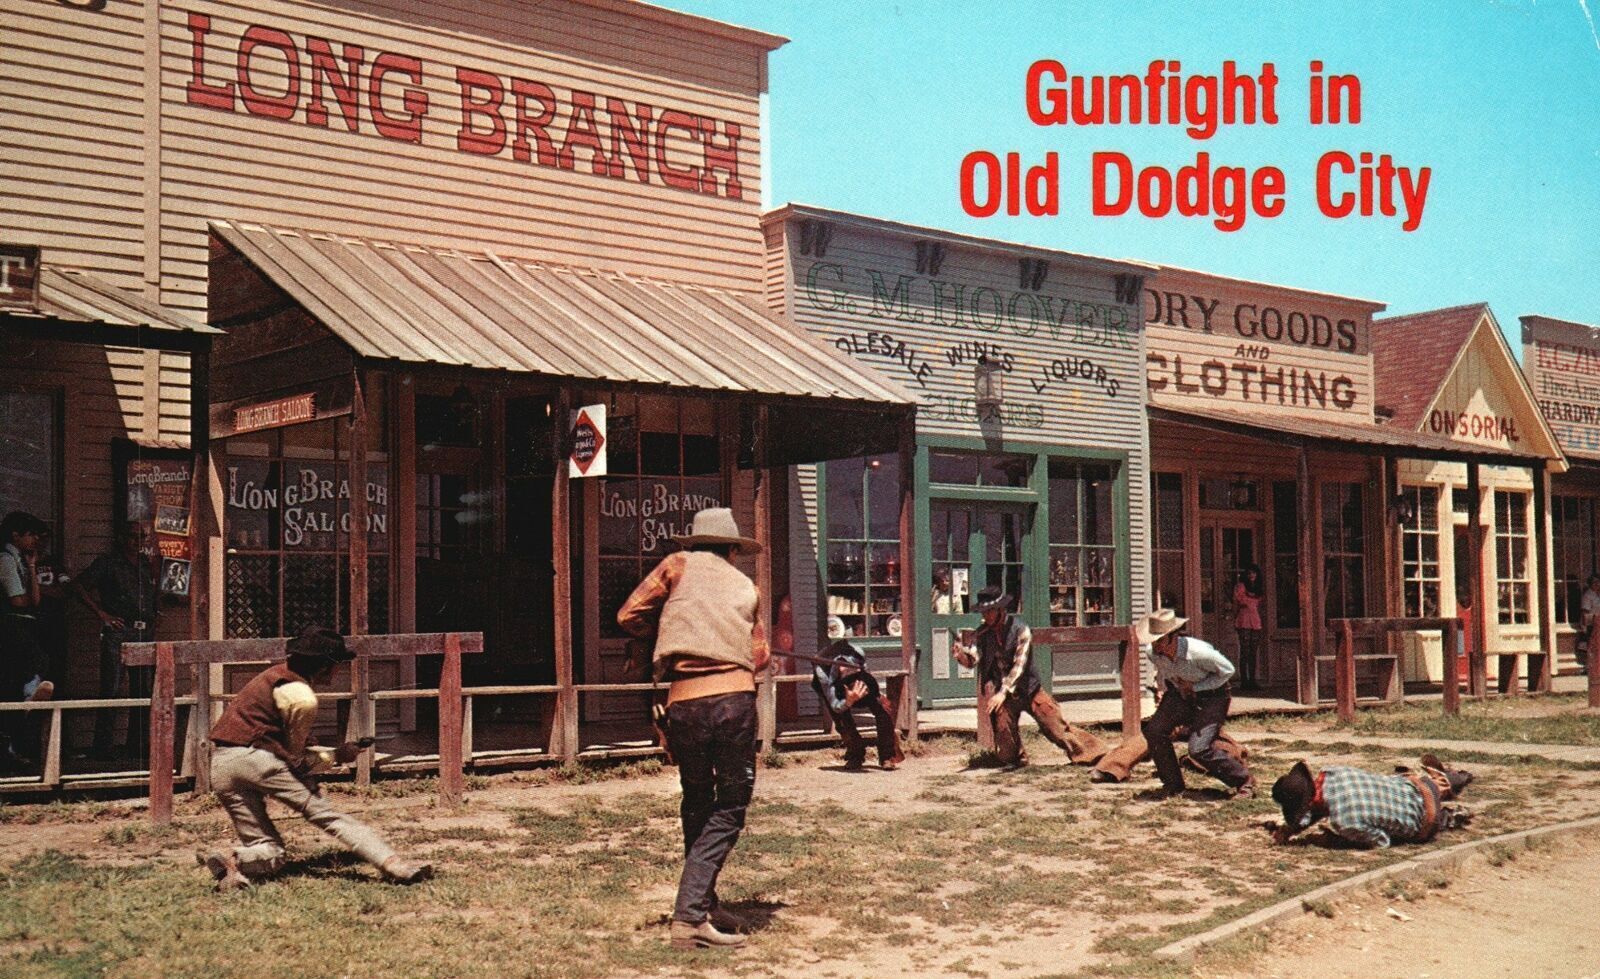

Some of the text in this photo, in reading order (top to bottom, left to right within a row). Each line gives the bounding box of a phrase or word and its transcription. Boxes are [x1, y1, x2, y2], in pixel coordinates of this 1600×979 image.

[187, 11, 742, 200] LONG BRANCH
[1145, 288, 1357, 353] DRY GOODS
[836, 333, 932, 388] OLESALE
[1031, 357, 1120, 398] LIQUORS
[1146, 351, 1357, 410] CLOTHING
[1235, 344, 1270, 360] AND
[1423, 409, 1519, 442] ONSORIAL
[1540, 400, 1600, 425] HARDW
